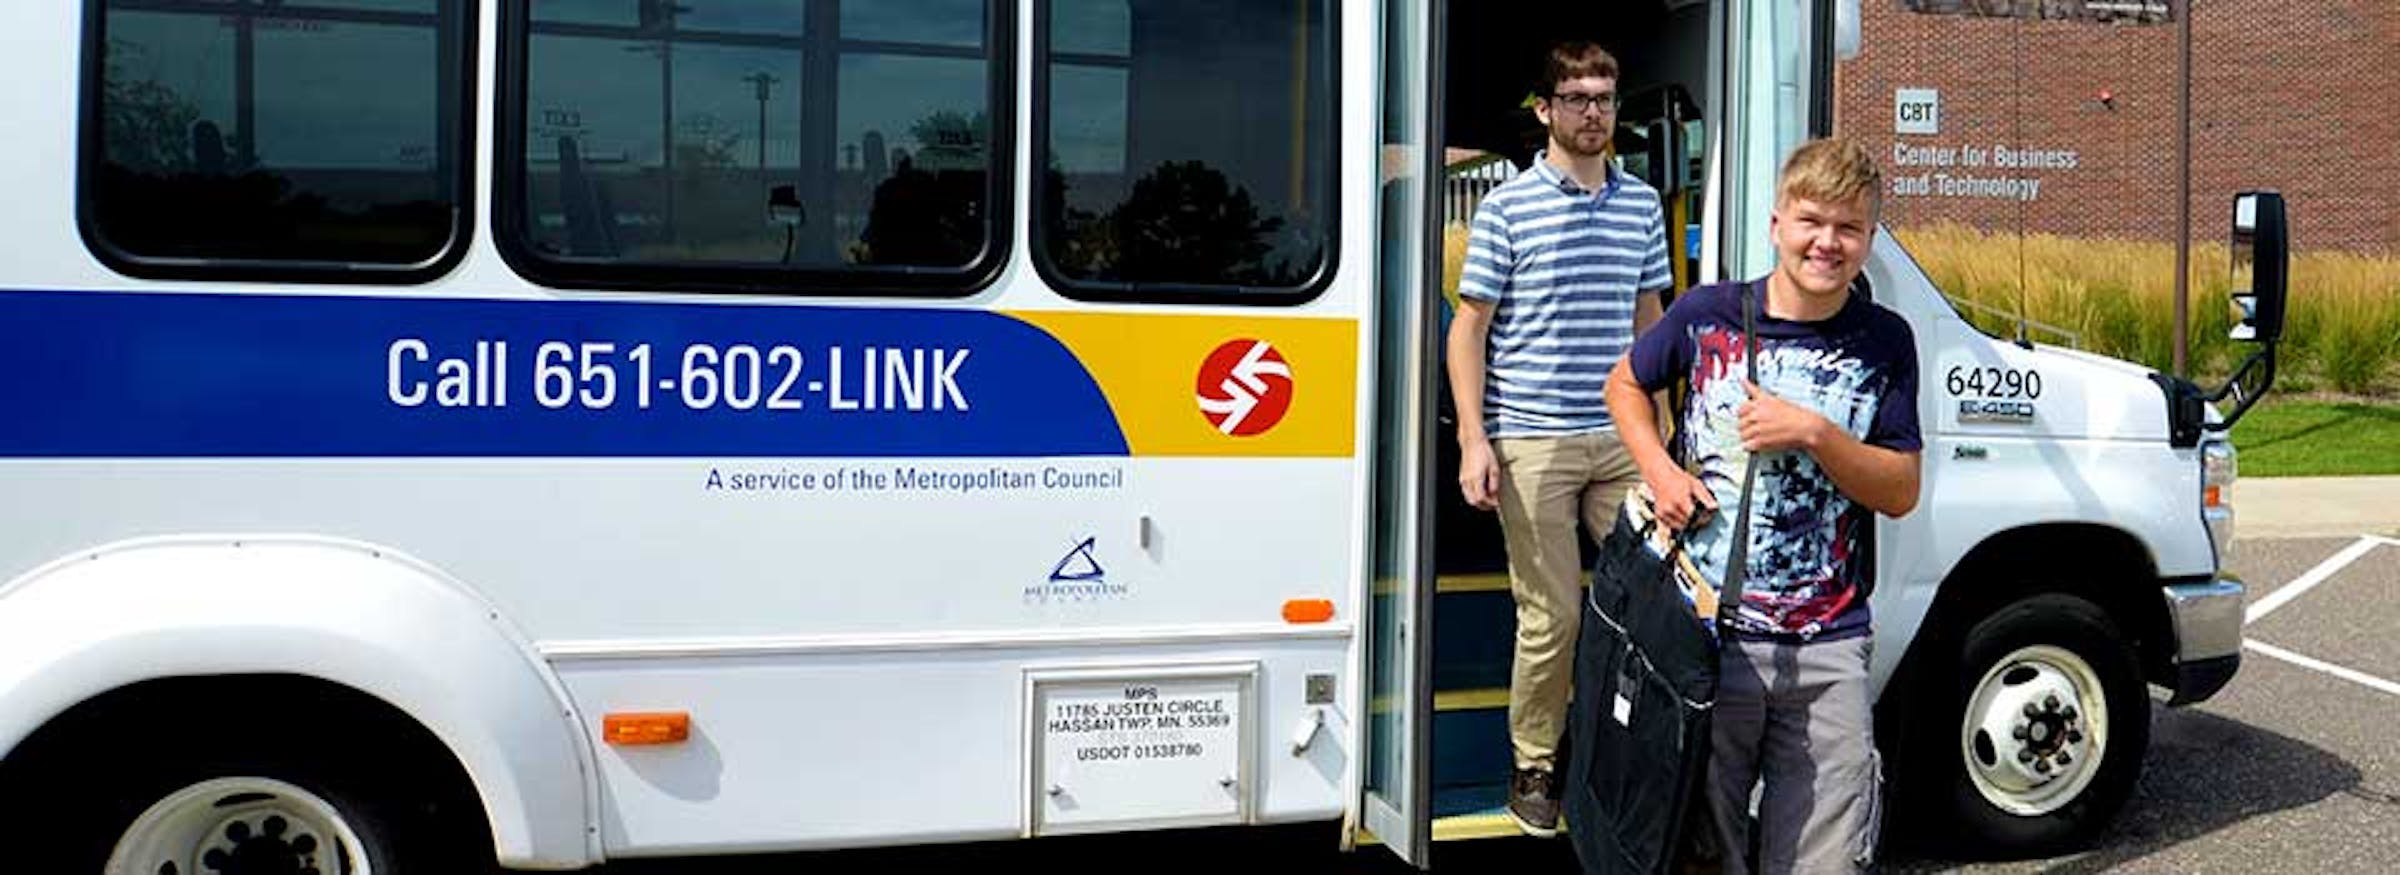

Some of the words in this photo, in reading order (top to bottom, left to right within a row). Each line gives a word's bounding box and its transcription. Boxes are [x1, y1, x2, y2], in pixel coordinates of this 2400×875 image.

[1900, 102, 1933, 121] CBT
[1894, 142, 1955, 166] Center
[1963, 144, 1988, 167] for
[1994, 144, 2080, 168] Business
[1893, 174, 1930, 195] and
[1935, 174, 2041, 201] Technology
[387, 338, 507, 407] Call
[534, 341, 971, 412] 651-602-LINK
[1947, 366, 2041, 399] 64290
[706, 469, 724, 490] A
[730, 468, 816, 490] service
[823, 468, 845, 490] of
[852, 468, 886, 490] the
[895, 467, 1036, 492] Metropolitan
[1042, 467, 1123, 490] Council
[1124, 687, 1158, 700] MPS
[1103, 702, 1163, 716] JUSTEN
[1167, 700, 1223, 714] CIRCLE
[1049, 718, 1114, 733] HASSAN
[1189, 715, 1231, 728] 55369
[1077, 747, 1130, 760] USDOT
